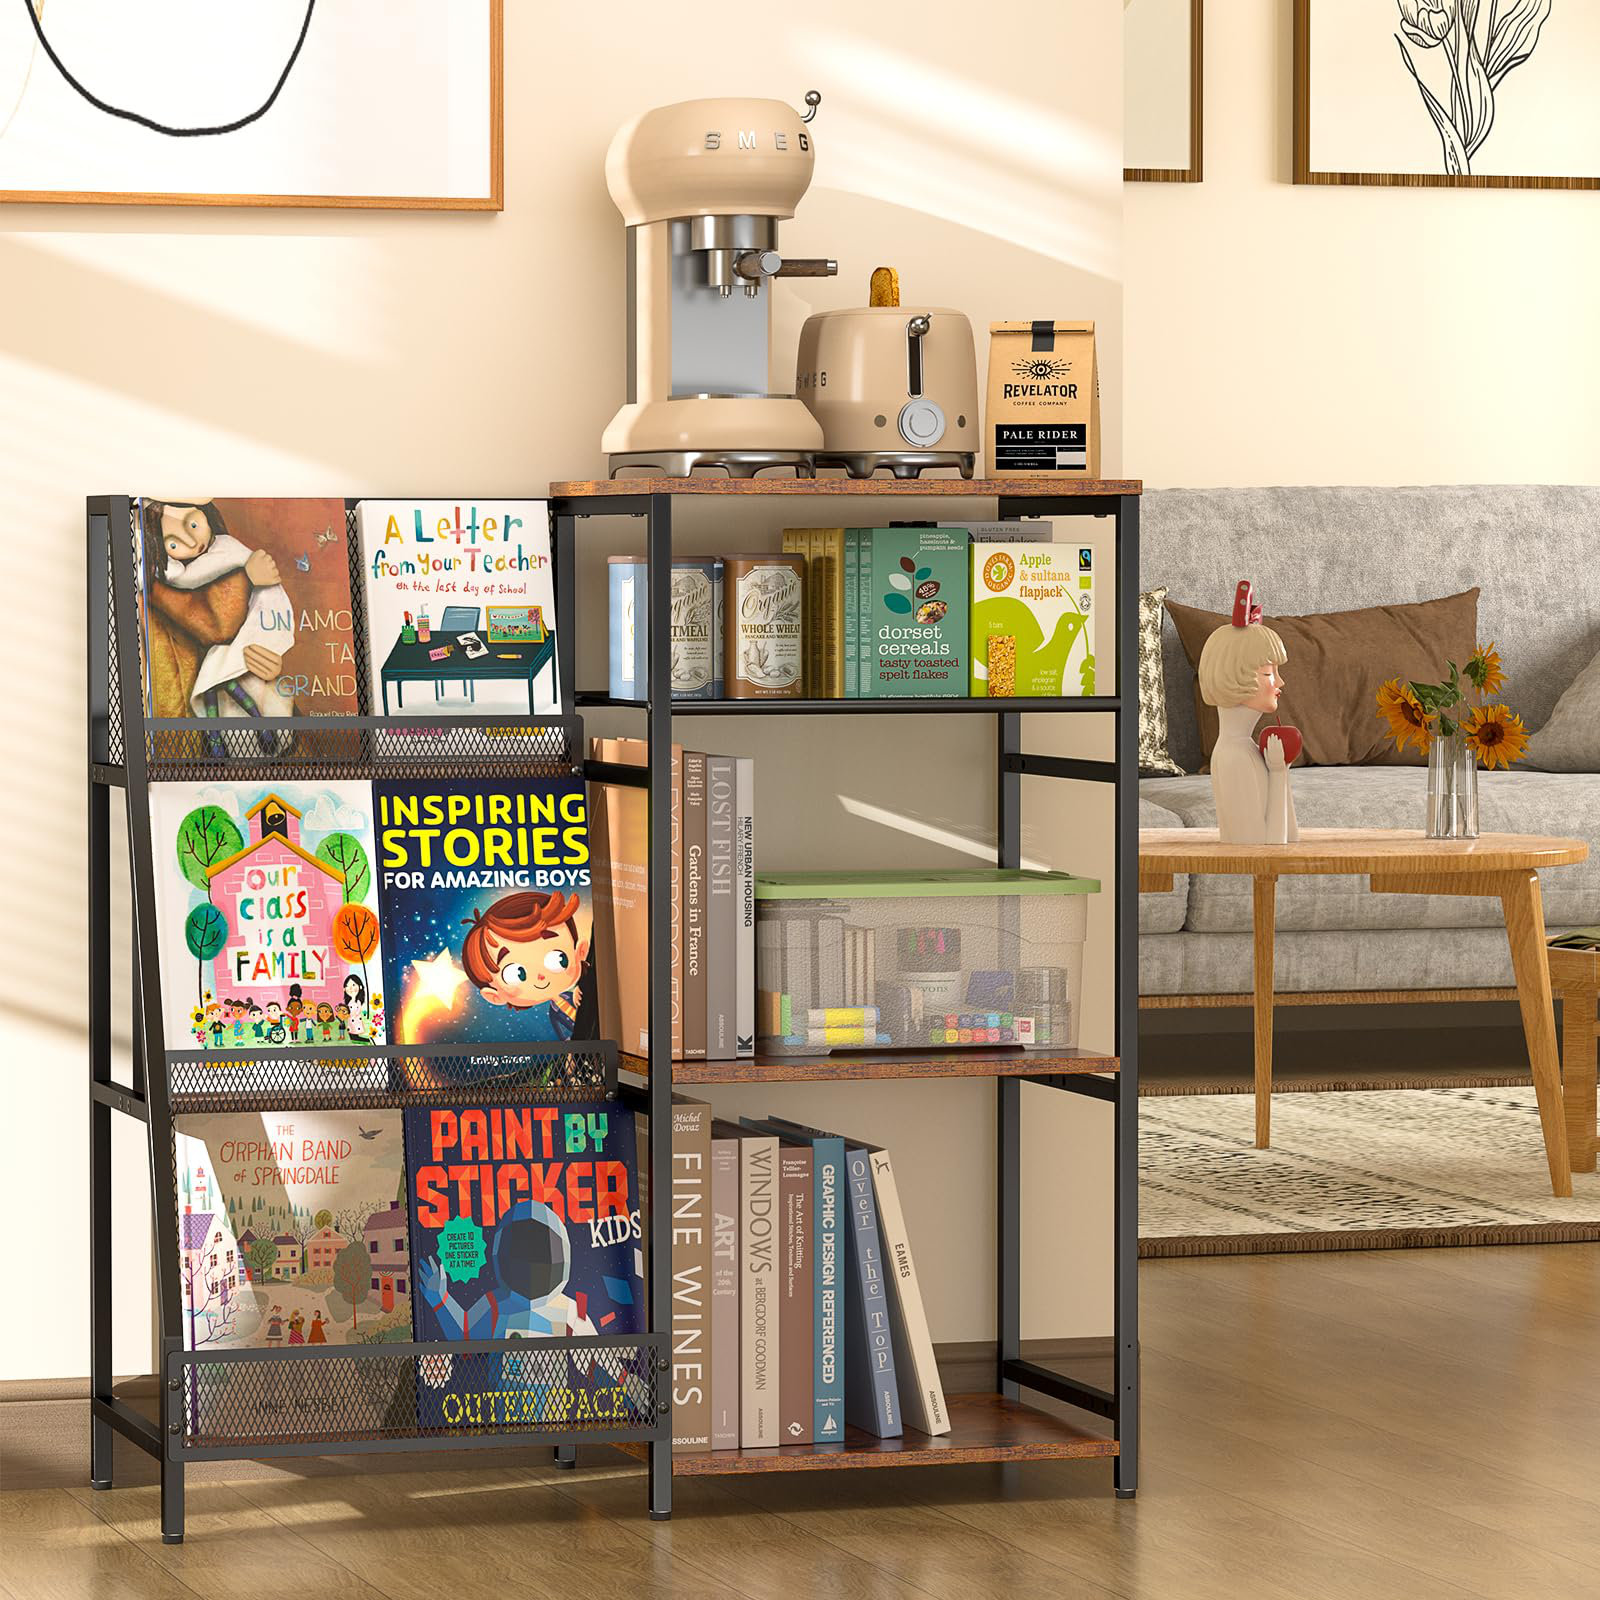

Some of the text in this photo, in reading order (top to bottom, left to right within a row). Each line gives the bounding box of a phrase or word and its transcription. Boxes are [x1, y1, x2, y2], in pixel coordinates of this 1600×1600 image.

[704, 131, 809, 152] SMEG
[1003, 384, 1078, 399] REVELATOR
[1003, 430, 1078, 440] PALE RIDER
[384, 506, 523, 544] A Letter
[371, 544, 548, 579] from your Teacher
[1019, 553, 1051, 569] Apple
[412, 580, 430, 592] the
[435, 578, 457, 592] last
[463, 581, 479, 596] day
[483, 584, 495, 595] of
[498, 582, 527, 594] School
[1019, 570, 1071, 582] & sultana
[741, 579, 797, 619] Organic
[1019, 585, 1063, 601] flapjack
[260, 609, 353, 632] UN AMO
[671, 625, 709, 637] TMEAL
[741, 624, 774, 634] WHOLE
[878, 625, 942, 640] dorset
[325, 642, 355, 664] TA
[878, 641, 950, 655] cereals
[879, 657, 959, 670] tasty toasted
[276, 675, 357, 697] GRAND
[879, 670, 949, 682] spelt flakes
[379, 793, 586, 827] INSPIRING
[711, 765, 731, 895] LOST FISH
[381, 826, 590, 869] STORIES
[383, 871, 426, 890] FOR
[430, 869, 530, 889] AMAZING
[535, 868, 591, 888] BOYS
[744, 817, 753, 927] NEW URBAN HOUSING
[239, 890, 307, 921] class
[688, 845, 702, 976] Gardens in France
[258, 925, 297, 947] is a
[236, 948, 328, 981] FAMILY
[673, 1112, 702, 1123] Michel
[673, 1123, 700, 1132] Dovaz
[276, 1124, 295, 1136] THE
[430, 1107, 608, 1162] PAINT BY
[219, 1139, 352, 1163] ORPHAN BAND
[233, 1165, 340, 1186] of SPRINGDALE
[416, 1160, 630, 1229] STICKER
[822, 1164, 835, 1229] GRAPHIC
[446, 1232, 466, 1241] CREATE
[587, 1209, 642, 1248] KIDS
[714, 1213, 735, 1261] ART
[794, 1192, 805, 1269] The Art of Knitting
[457, 1250, 479, 1259] STICKER
[822, 1232, 835, 1285] DESIGN
[852, 1160, 888, 1369] Over the Top
[894, 1243, 911, 1279] EAMES
[672, 1153, 702, 1405] FINE WINES
[749, 1146, 772, 1391] WINDOWS at BERGDORF GOODMAN
[822, 1289, 835, 1384] REFERENCED
[929, 1390, 942, 1425] ASSOULINE
[672, 1436, 708, 1445] SSOULINE
